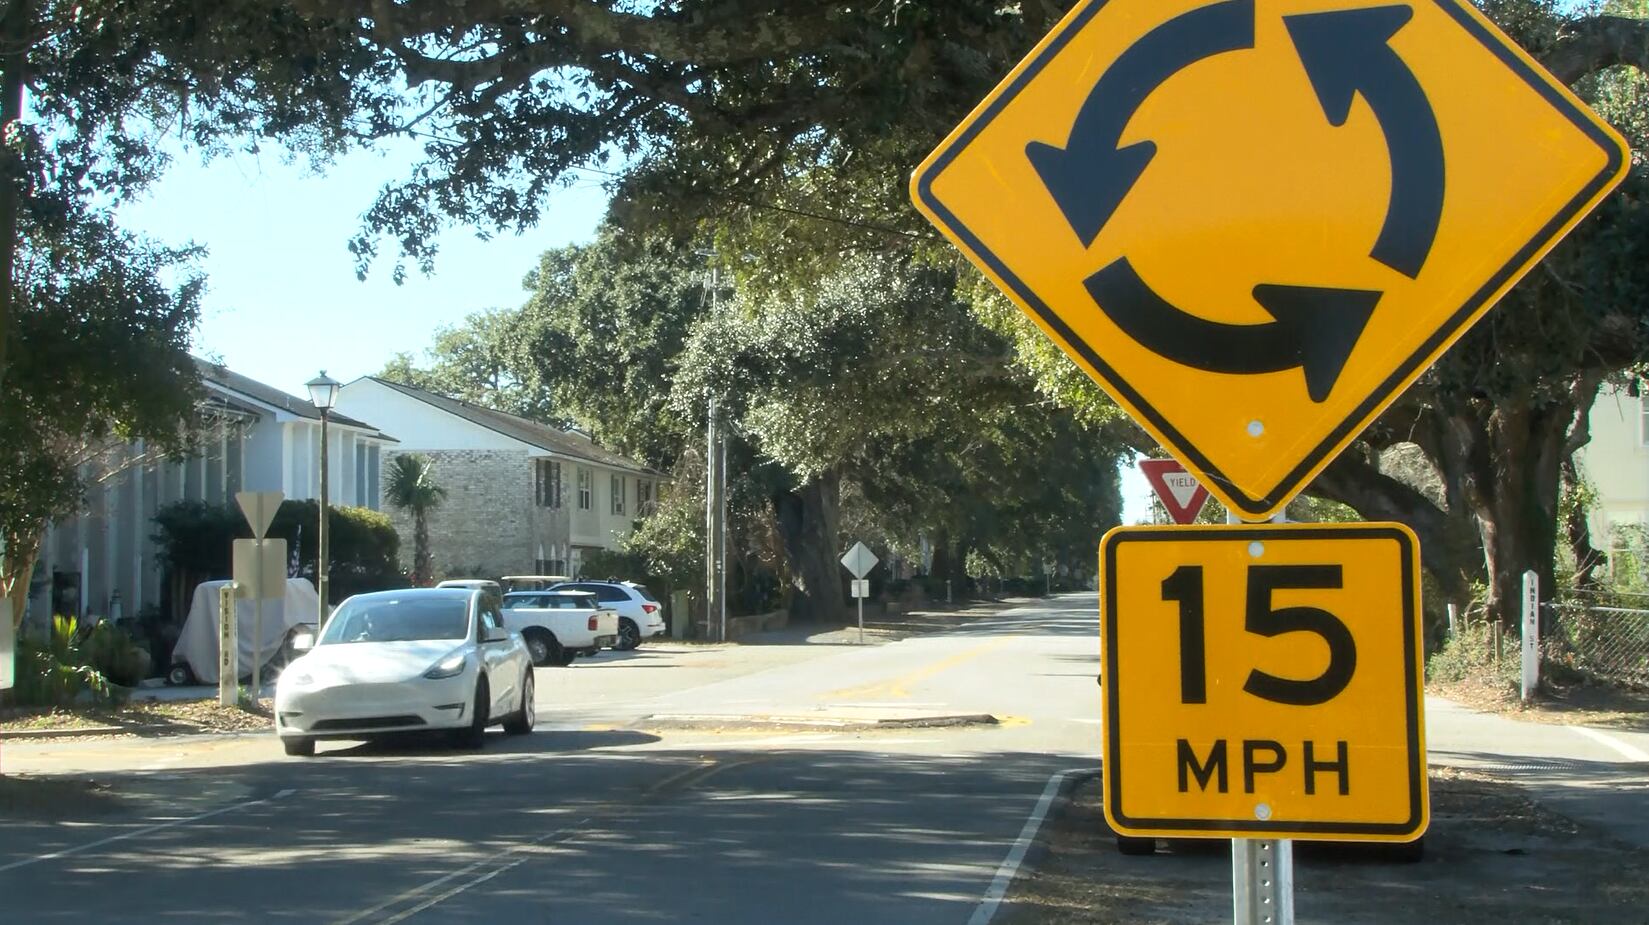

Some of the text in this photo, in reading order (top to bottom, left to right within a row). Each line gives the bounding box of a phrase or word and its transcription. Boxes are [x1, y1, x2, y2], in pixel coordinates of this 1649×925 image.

[1169, 477, 1196, 487] YIELD
[1160, 564, 1357, 706] 15
[1176, 738, 1350, 796] MPH
